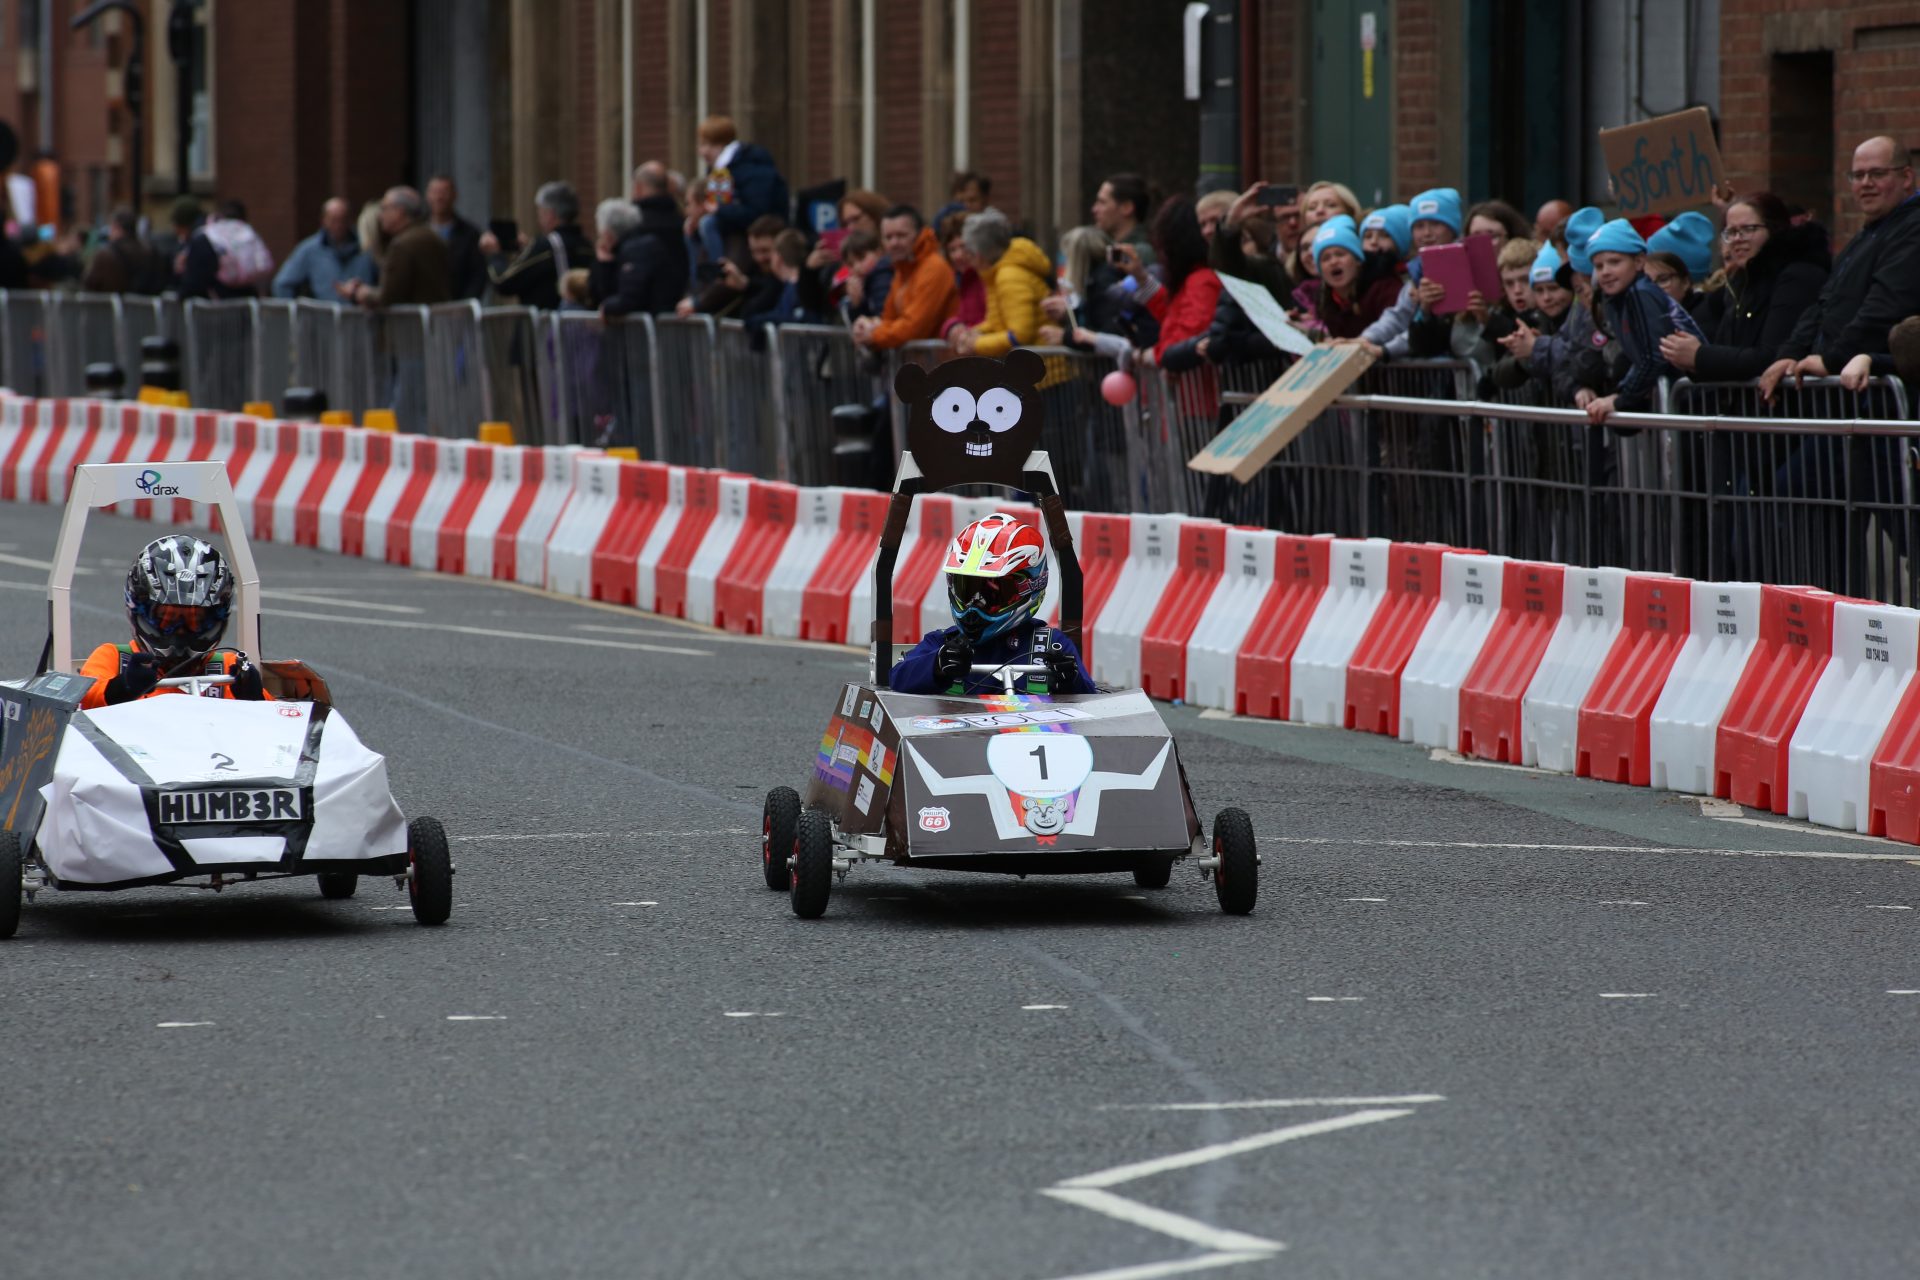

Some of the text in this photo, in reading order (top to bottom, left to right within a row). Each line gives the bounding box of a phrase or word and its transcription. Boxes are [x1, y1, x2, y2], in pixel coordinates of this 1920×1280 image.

[1611, 129, 1714, 211] sforth
[816, 203, 836, 233] P
[152, 484, 179, 496] drax
[963, 707, 1076, 727] BOLT
[211, 752, 239, 772] 2
[1029, 745, 1048, 780] 1
[161, 791, 300, 823] HUMB3R
[925, 817, 943, 827] 66
